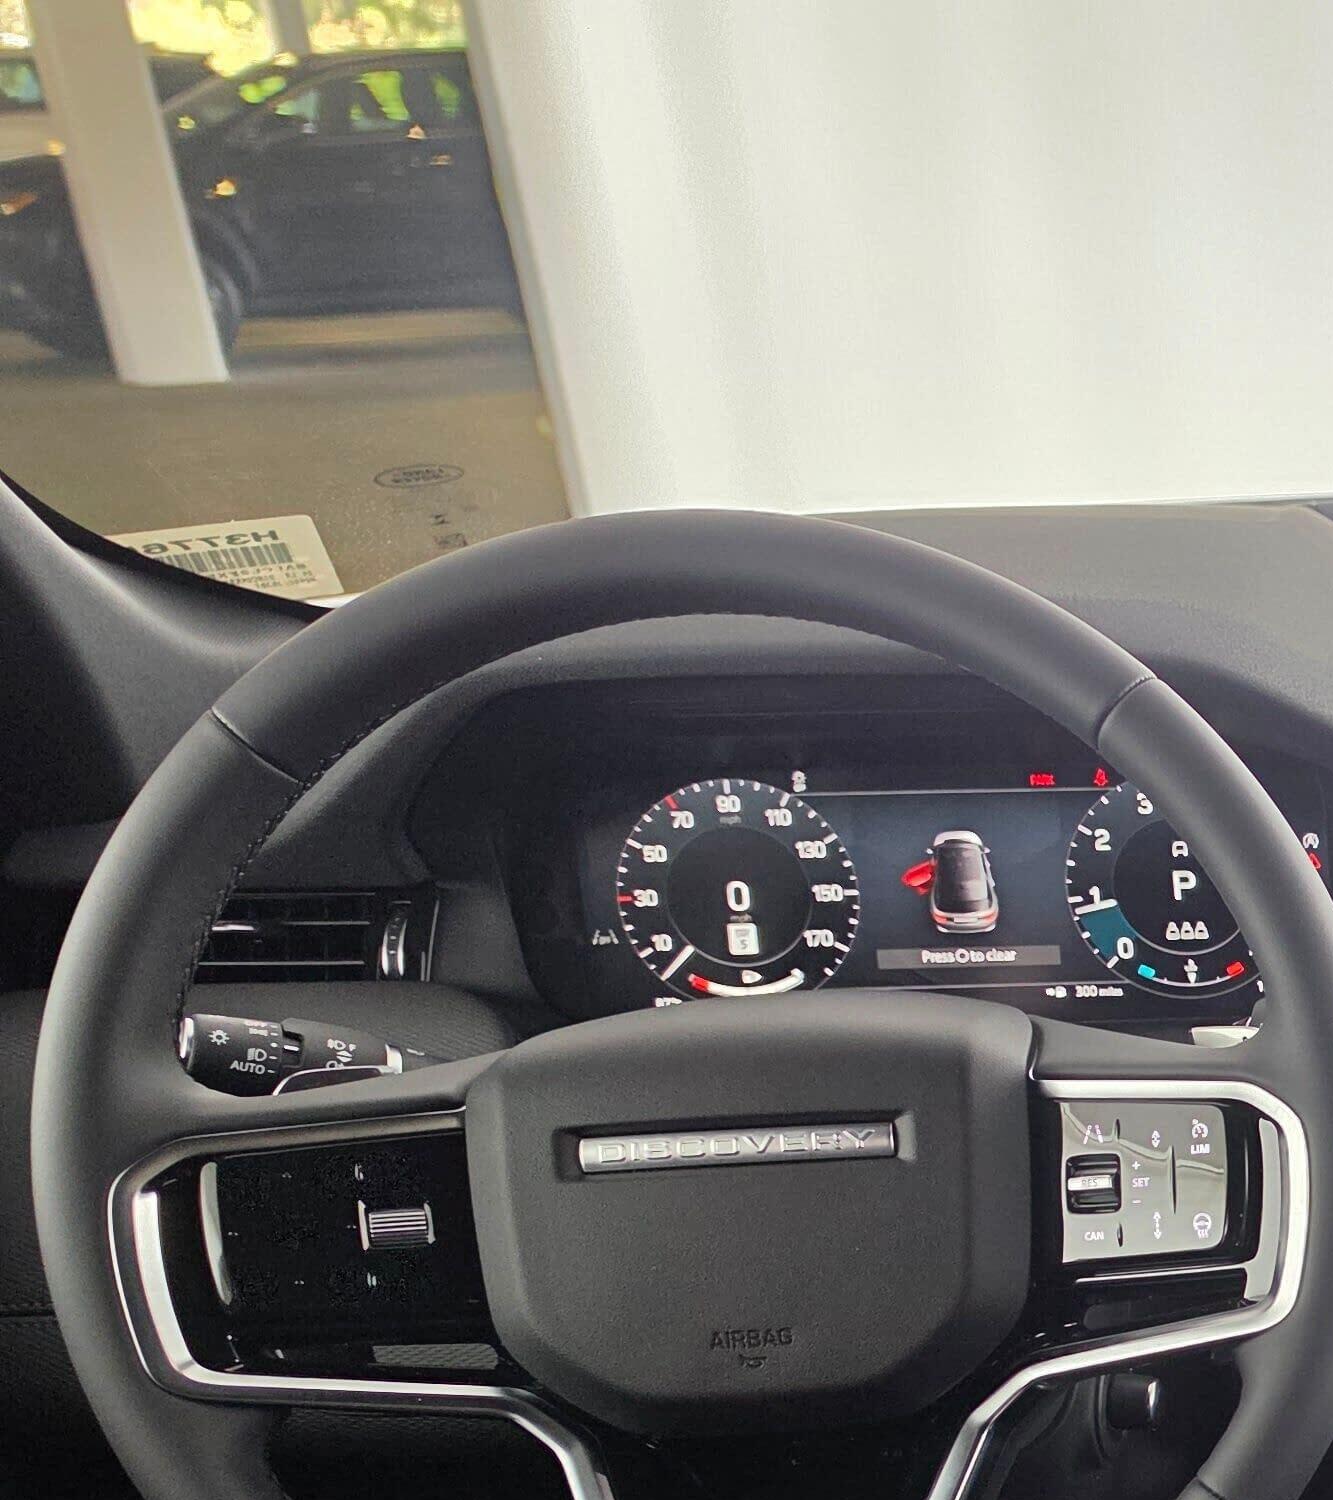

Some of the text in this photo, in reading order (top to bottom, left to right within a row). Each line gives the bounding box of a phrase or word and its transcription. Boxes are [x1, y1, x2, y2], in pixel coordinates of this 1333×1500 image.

[715, 795, 741, 813] 90
[1136, 792, 1153, 815] 3
[670, 810, 695, 829] 70
[764, 807, 793, 827] 110
[795, 840, 827, 858] 130
[1094, 828, 1112, 851] 2
[642, 844, 668, 863] 50
[811, 884, 844, 902] 150
[1172, 870, 1197, 901] P
[633, 889, 659, 908] 30
[726, 880, 751, 912] 0
[651, 933, 673, 951] 10
[803, 929, 835, 948] 170
[921, 947, 1018, 964] Press to clear
[1117, 937, 1135, 960] 0
[230, 1060, 265, 1075] AUTO
[598, 1128, 876, 1164] DISCOVERY
[1190, 1143, 1210, 1154] LIM
[1132, 1177, 1150, 1188] SET
[1084, 1231, 1104, 1241] CAN
[710, 1326, 793, 1350] AIRBAG
